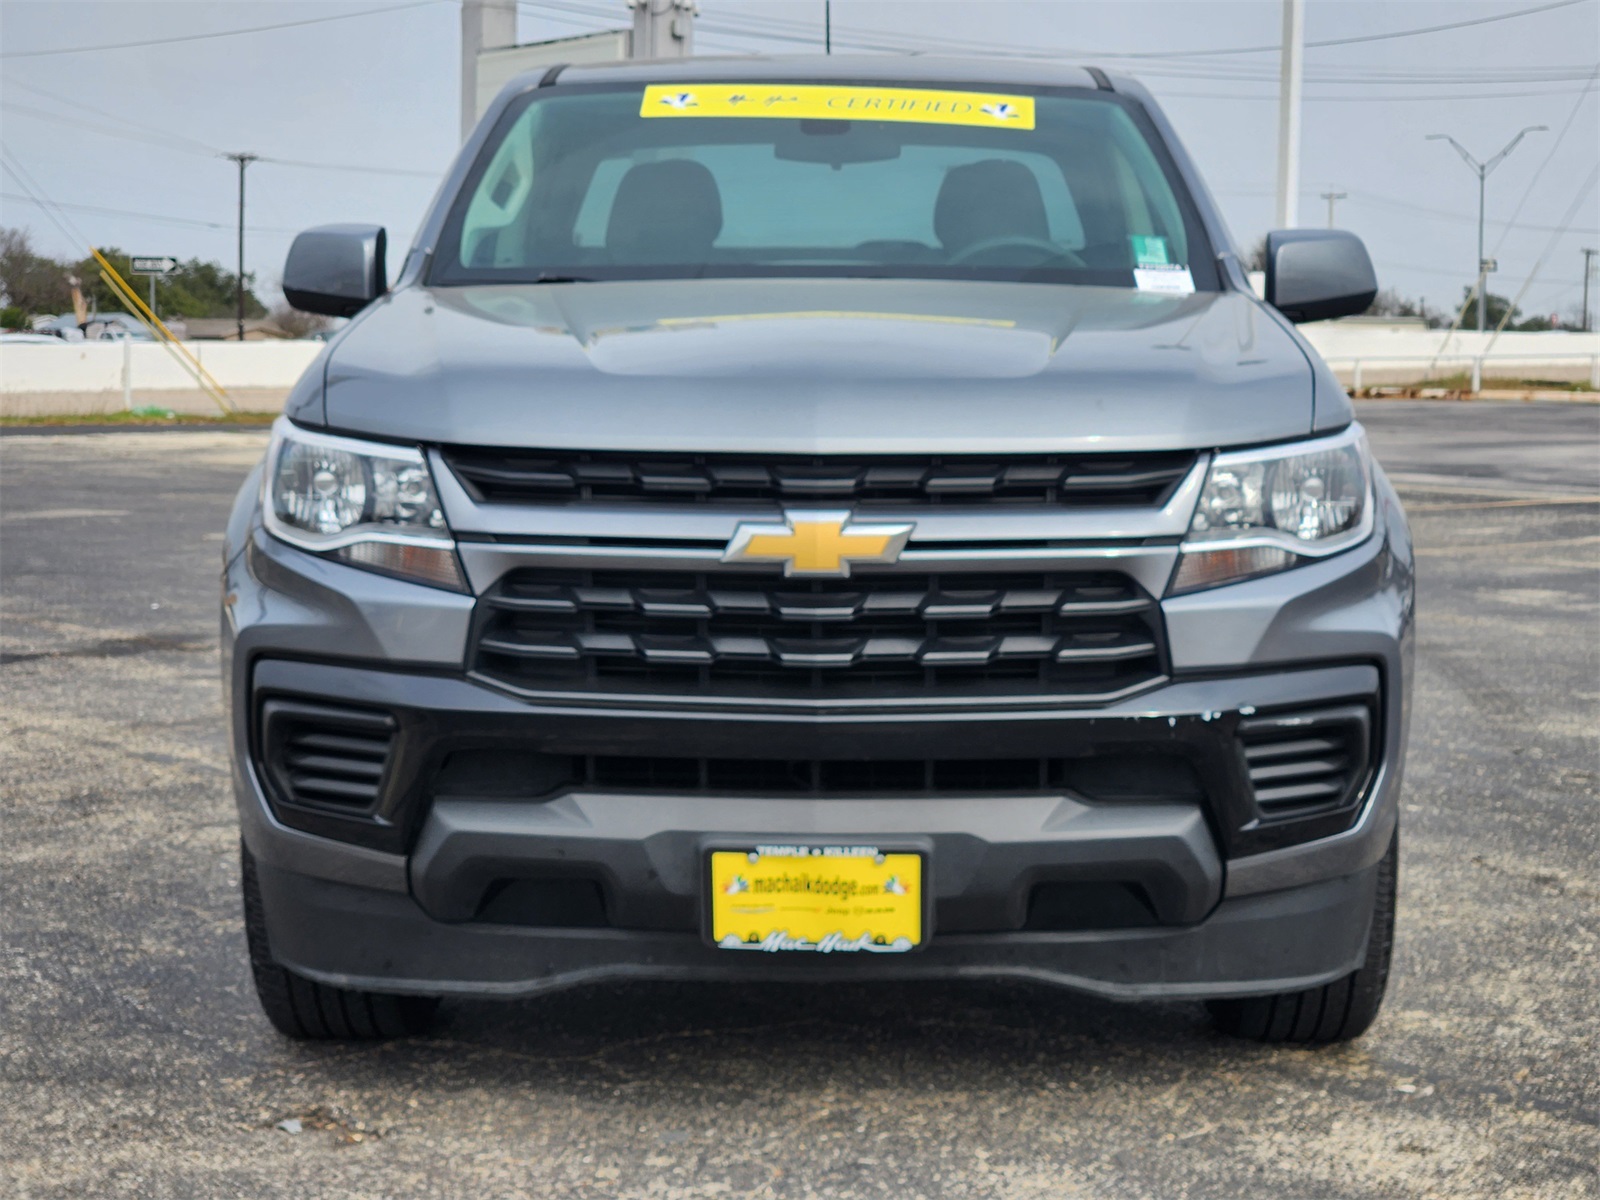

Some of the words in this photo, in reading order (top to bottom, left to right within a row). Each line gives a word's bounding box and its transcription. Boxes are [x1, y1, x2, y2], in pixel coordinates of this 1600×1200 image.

[827, 96, 973, 114] CERTIFIED
[756, 845, 810, 857] TEMPLE
[823, 846, 879, 858] KILLEEN
